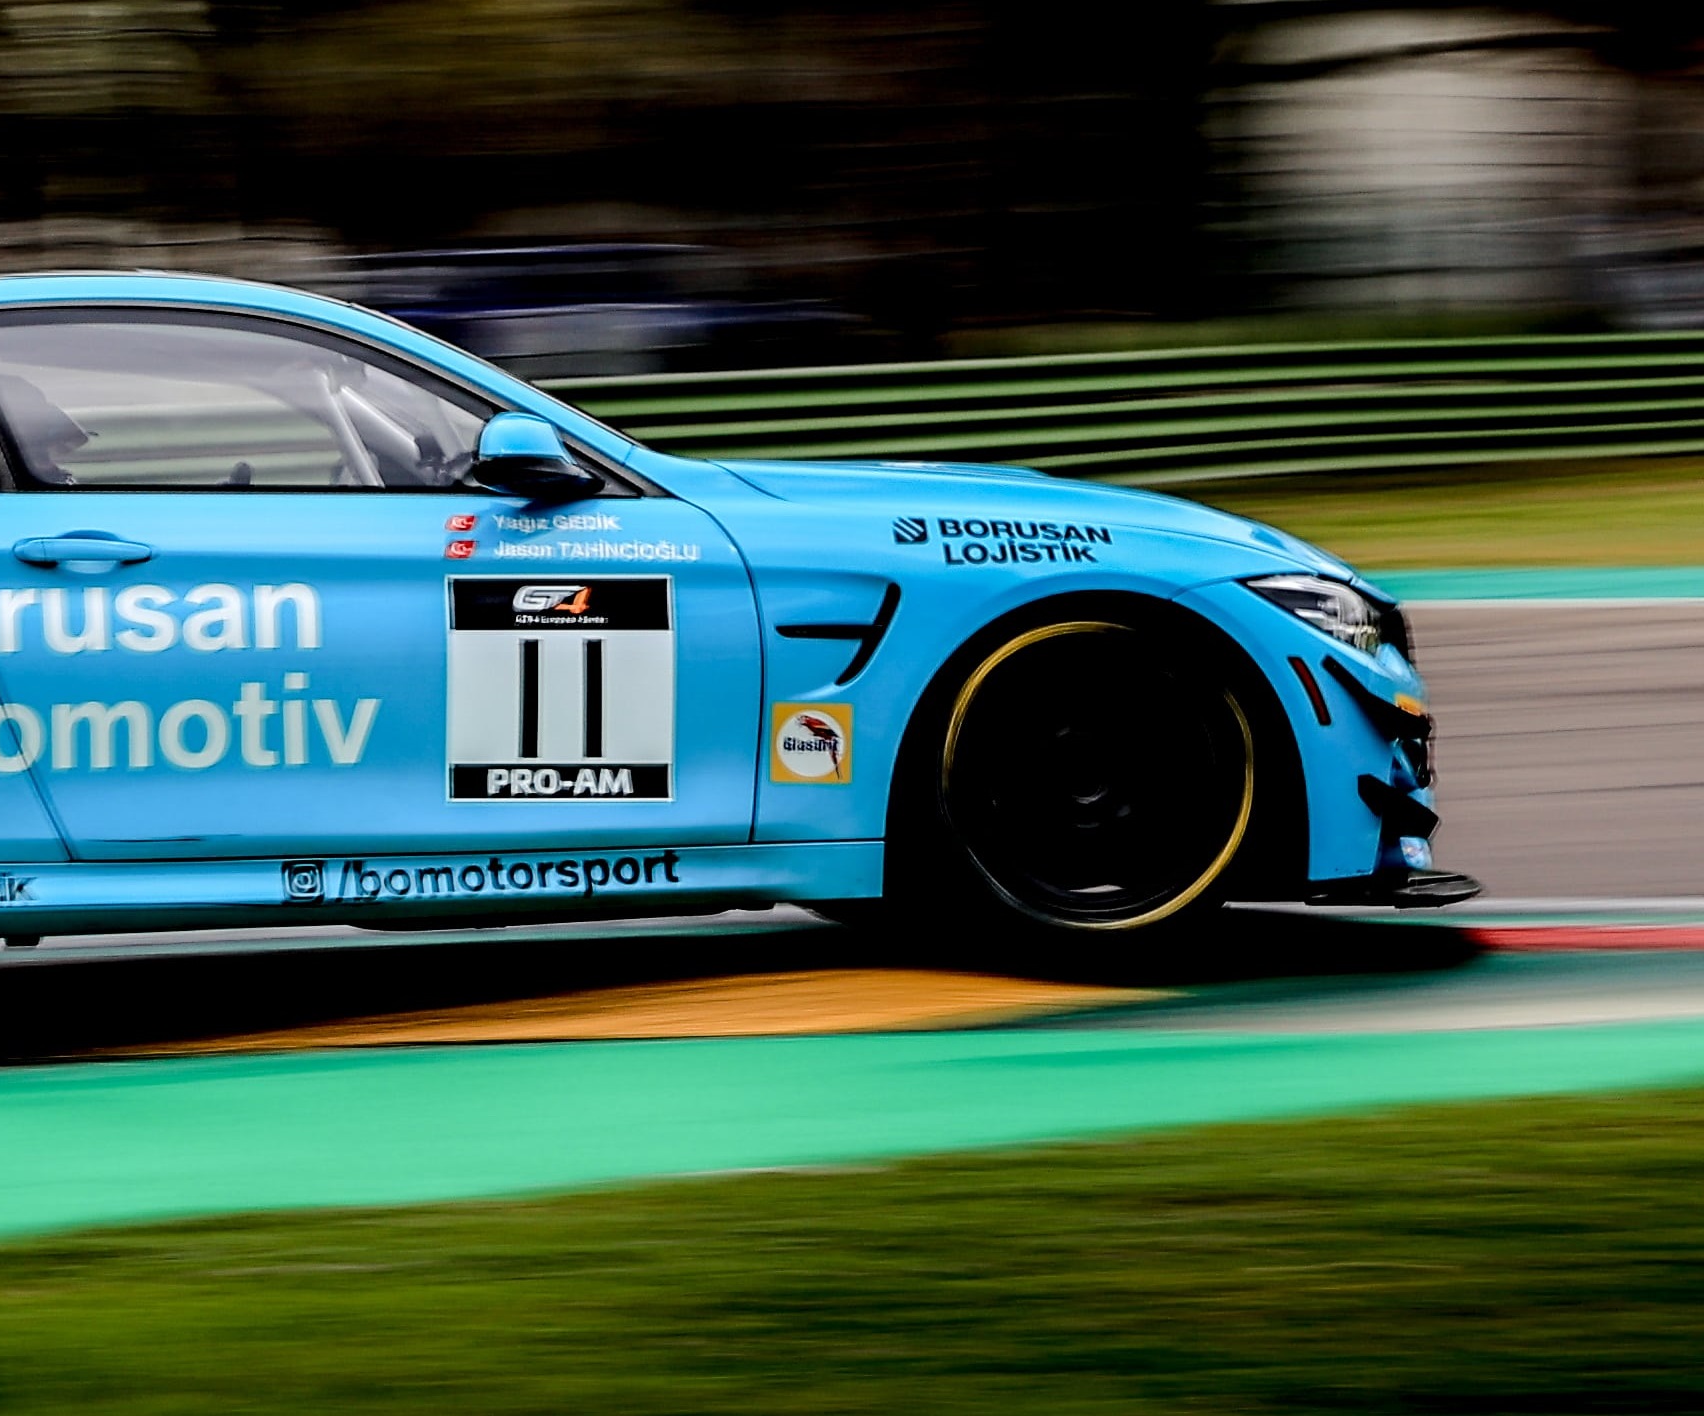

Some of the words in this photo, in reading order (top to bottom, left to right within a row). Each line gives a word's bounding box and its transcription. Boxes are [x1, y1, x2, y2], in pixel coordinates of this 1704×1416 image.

[938, 517, 1113, 545] BORUSAN
[495, 540, 553, 558] Jason
[942, 540, 1099, 565] LOJİSTİK
[512, 585, 592, 614] GT4
[518, 638, 603, 758] 11
[487, 768, 634, 796] PRO-AM
